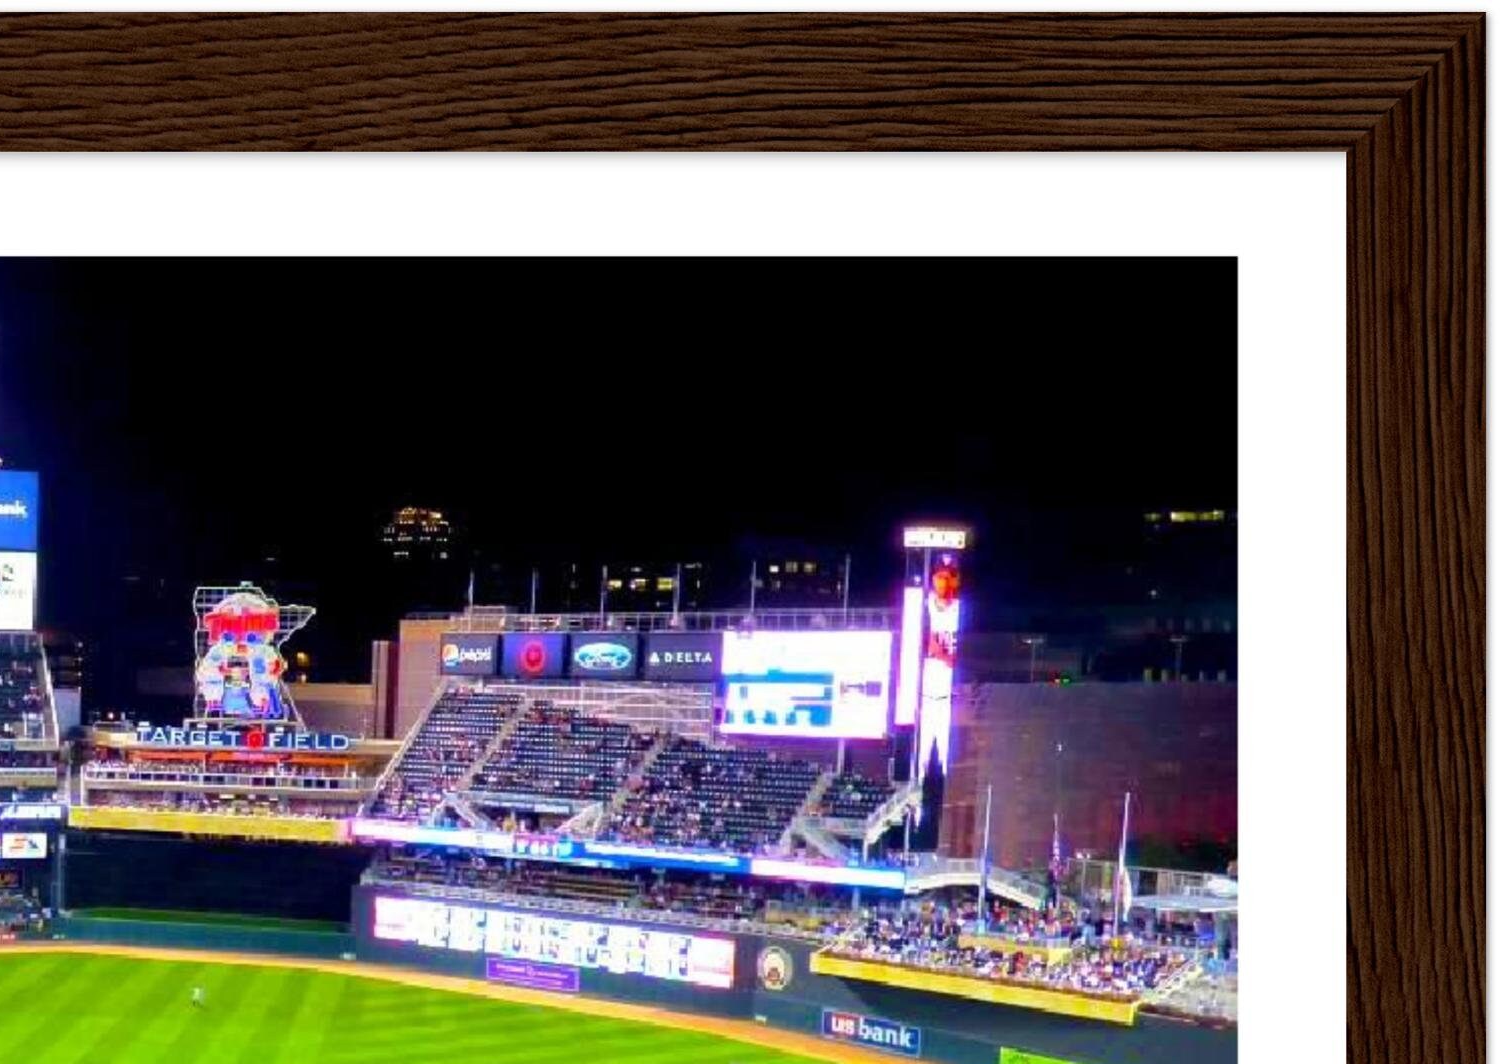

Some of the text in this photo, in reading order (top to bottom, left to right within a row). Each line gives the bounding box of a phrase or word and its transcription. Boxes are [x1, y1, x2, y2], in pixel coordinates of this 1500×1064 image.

[664, 651, 713, 664] DELTA
[136, 727, 350, 750] TARGET FIELD
[858, 1016, 913, 1048] bank
